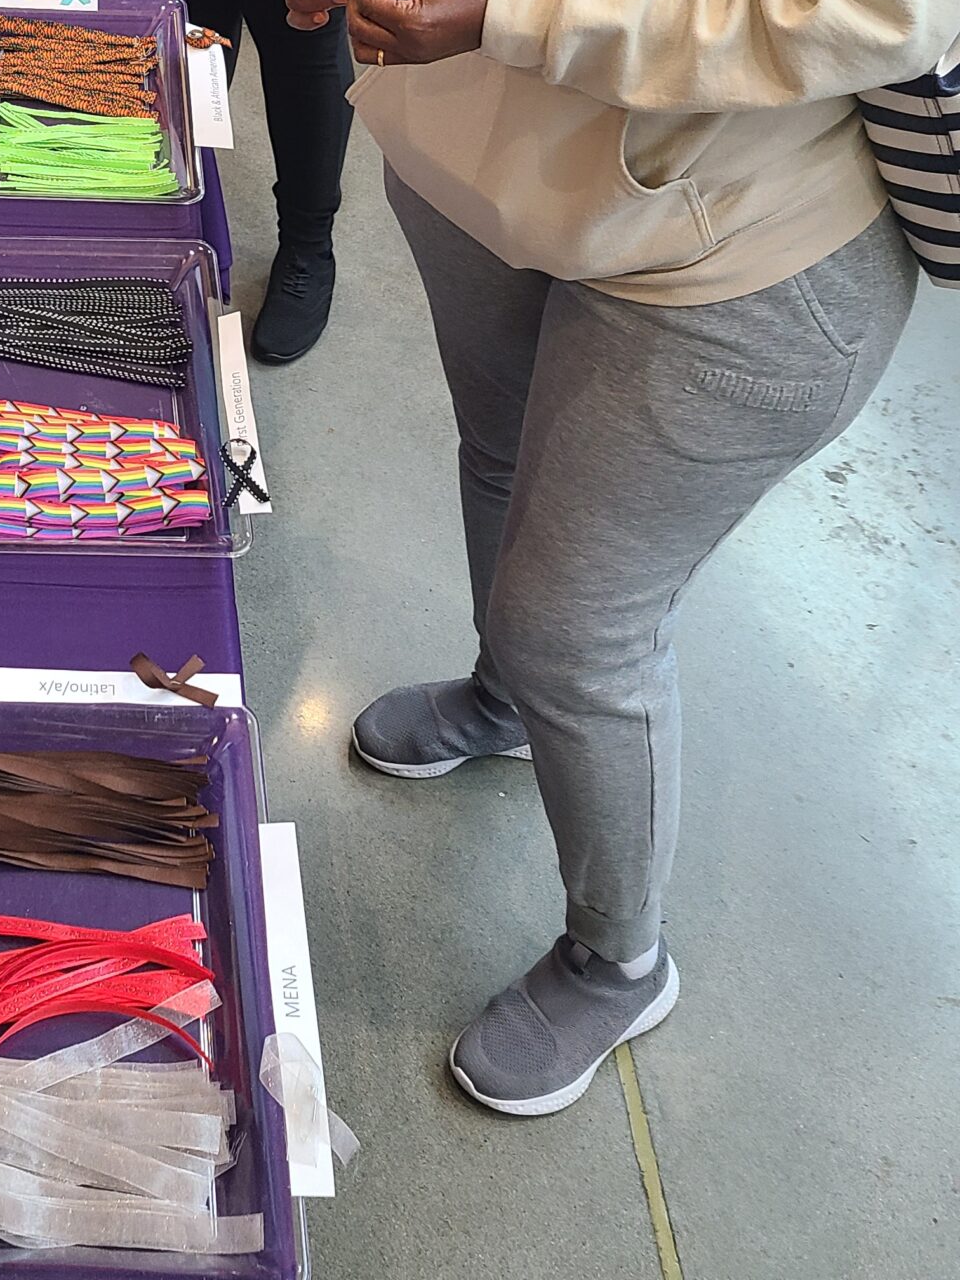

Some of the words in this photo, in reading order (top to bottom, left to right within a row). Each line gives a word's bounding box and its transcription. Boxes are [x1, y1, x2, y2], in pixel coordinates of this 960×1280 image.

[208, 51, 218, 78] American
[209, 79, 220, 99] African
[212, 107, 224, 122] Black
[230, 372, 246, 424] Generation
[39, 680, 115, 696] Latino/a/x
[281, 965, 301, 1018] MENA
